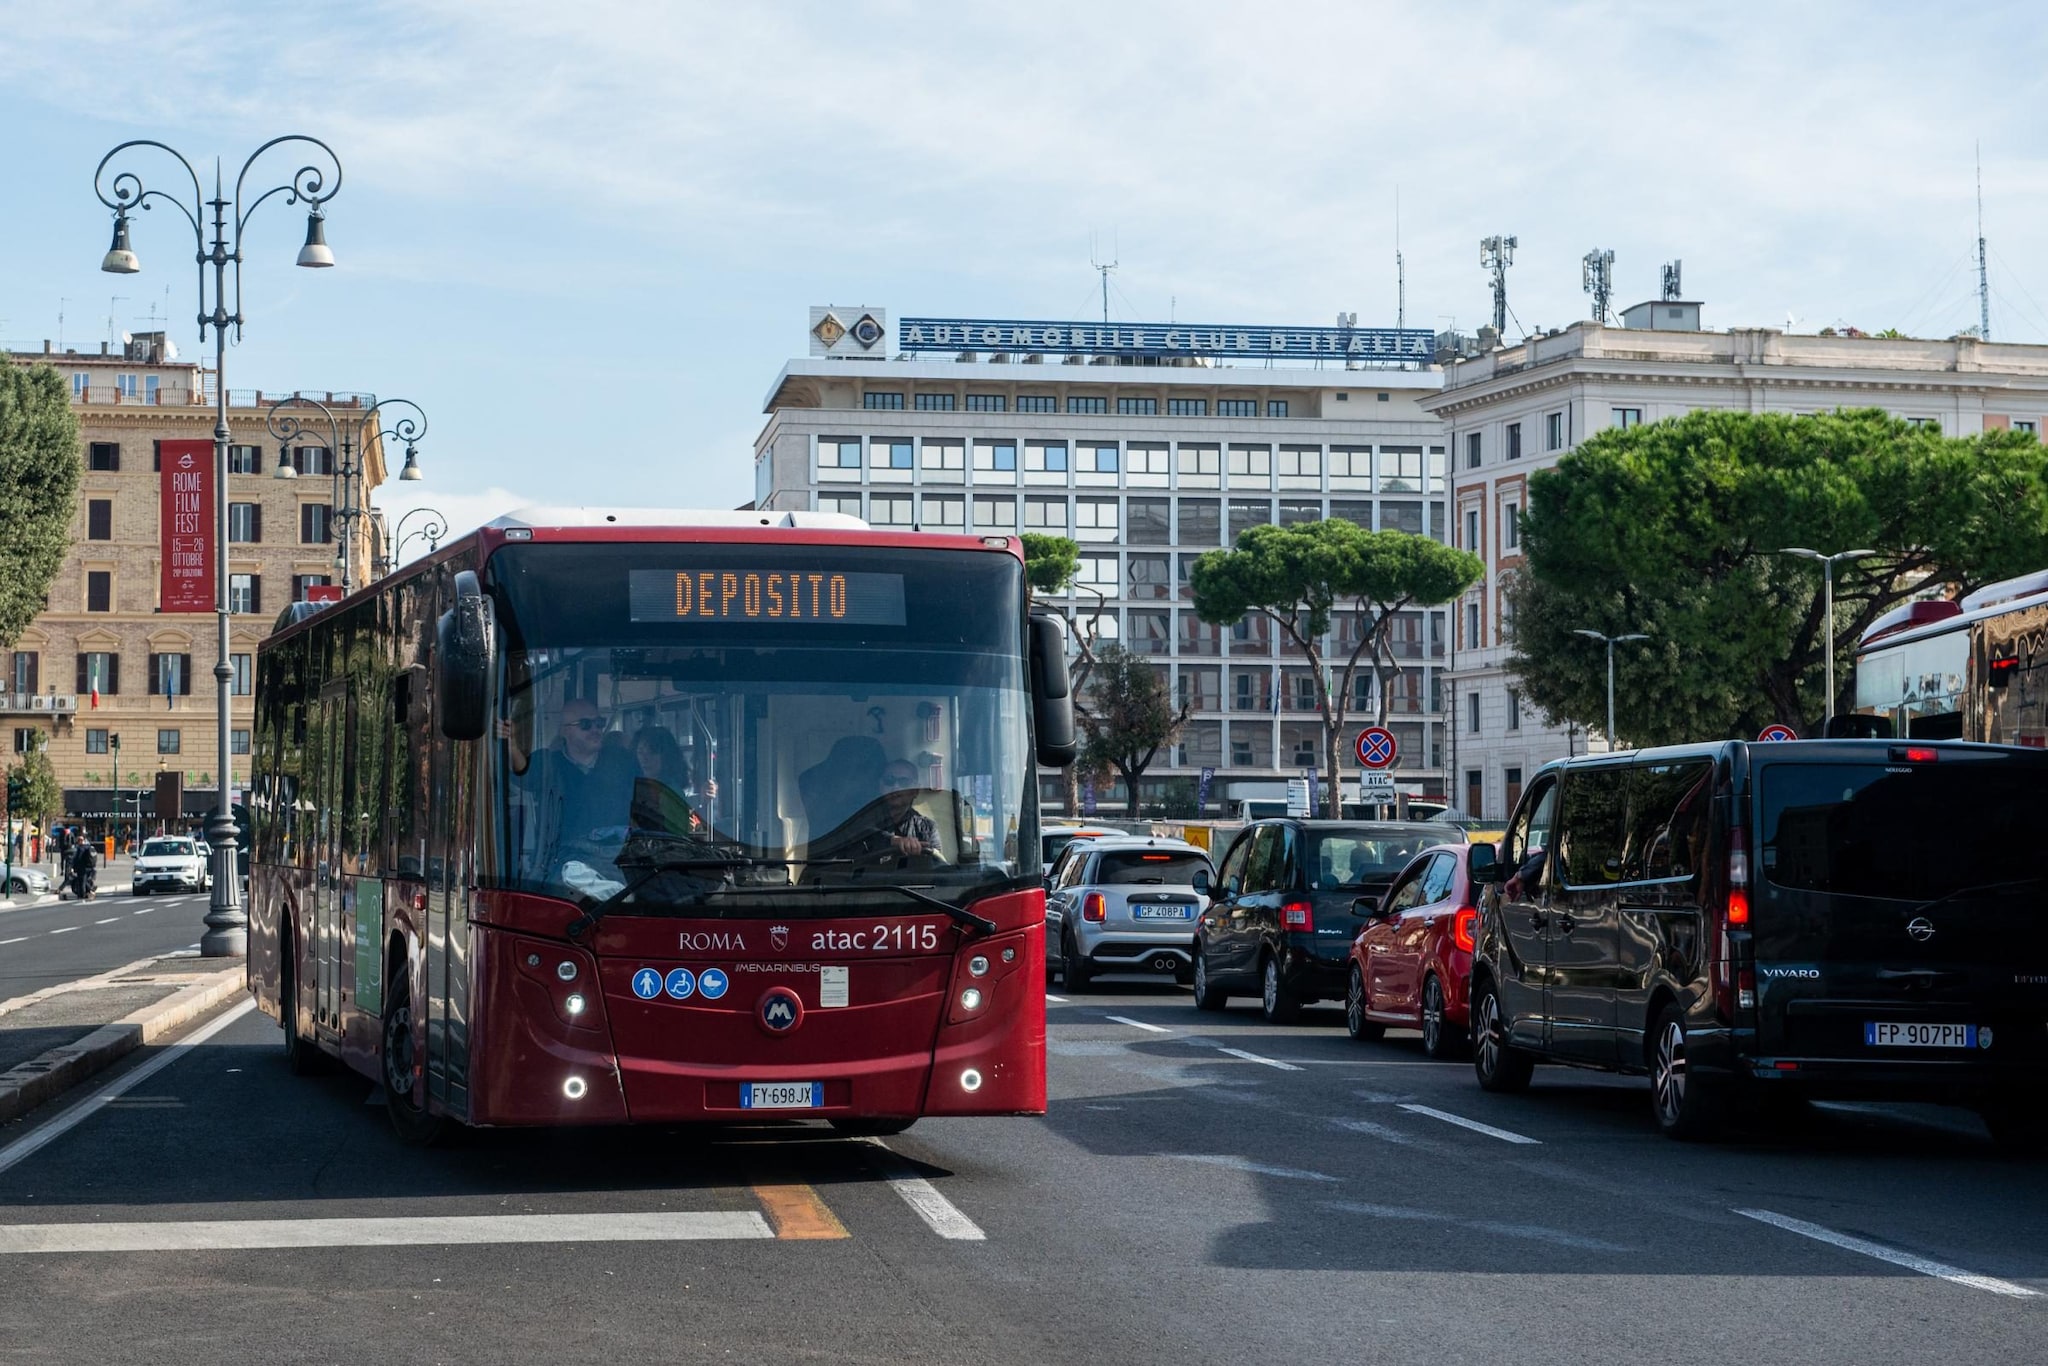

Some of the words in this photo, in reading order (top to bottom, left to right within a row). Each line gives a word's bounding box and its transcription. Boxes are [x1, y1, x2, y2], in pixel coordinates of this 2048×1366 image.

[906, 324, 1145, 348] AUTOMOBILE
[1165, 330, 1250, 350] CLUB
[1270, 333, 1428, 354] D'ITALIA
[173, 472, 202, 492] ROME
[175, 493, 200, 512] FILM
[175, 513, 200, 533] FEST
[172, 553, 204, 566] OTTOBRE
[676, 573, 846, 617] DEPOSITO
[1368, 777, 1388, 785] ATAC
[81, 811, 143, 819] PASTICERIA
[679, 932, 746, 950] ROMA
[811, 931, 867, 950] atac
[872, 924, 937, 950] 2115
[1763, 968, 1820, 979] VIVARO
